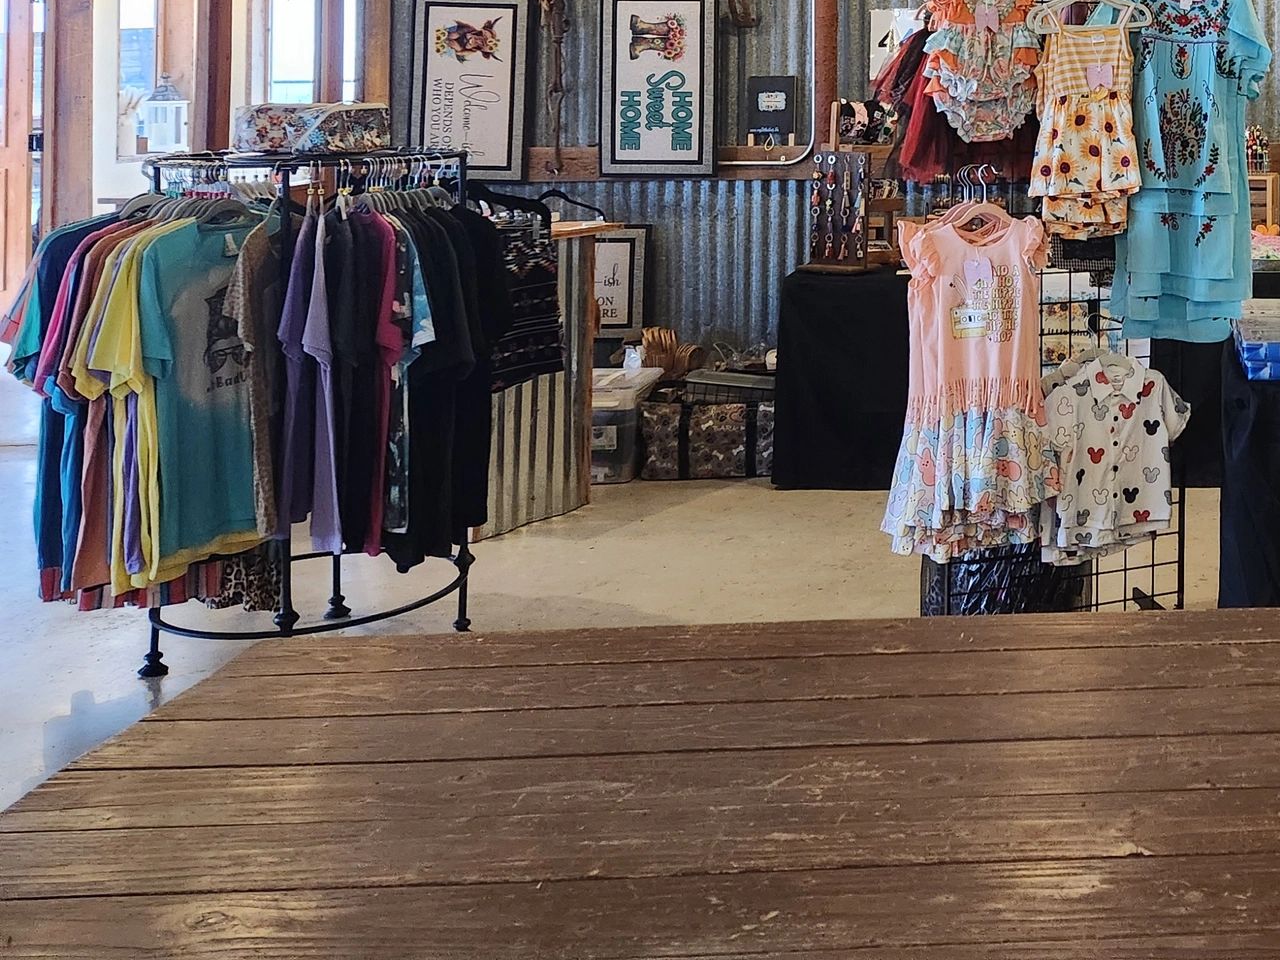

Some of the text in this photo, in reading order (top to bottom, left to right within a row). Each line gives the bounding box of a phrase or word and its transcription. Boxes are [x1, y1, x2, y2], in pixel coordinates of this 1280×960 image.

[430, 108, 441, 131] YOU
[432, 78, 443, 106] WHO
[442, 82, 455, 133] DEPENDS
[645, 70, 686, 131] Sweet
[619, 90, 642, 151] HOME
[671, 91, 693, 151] HOME
